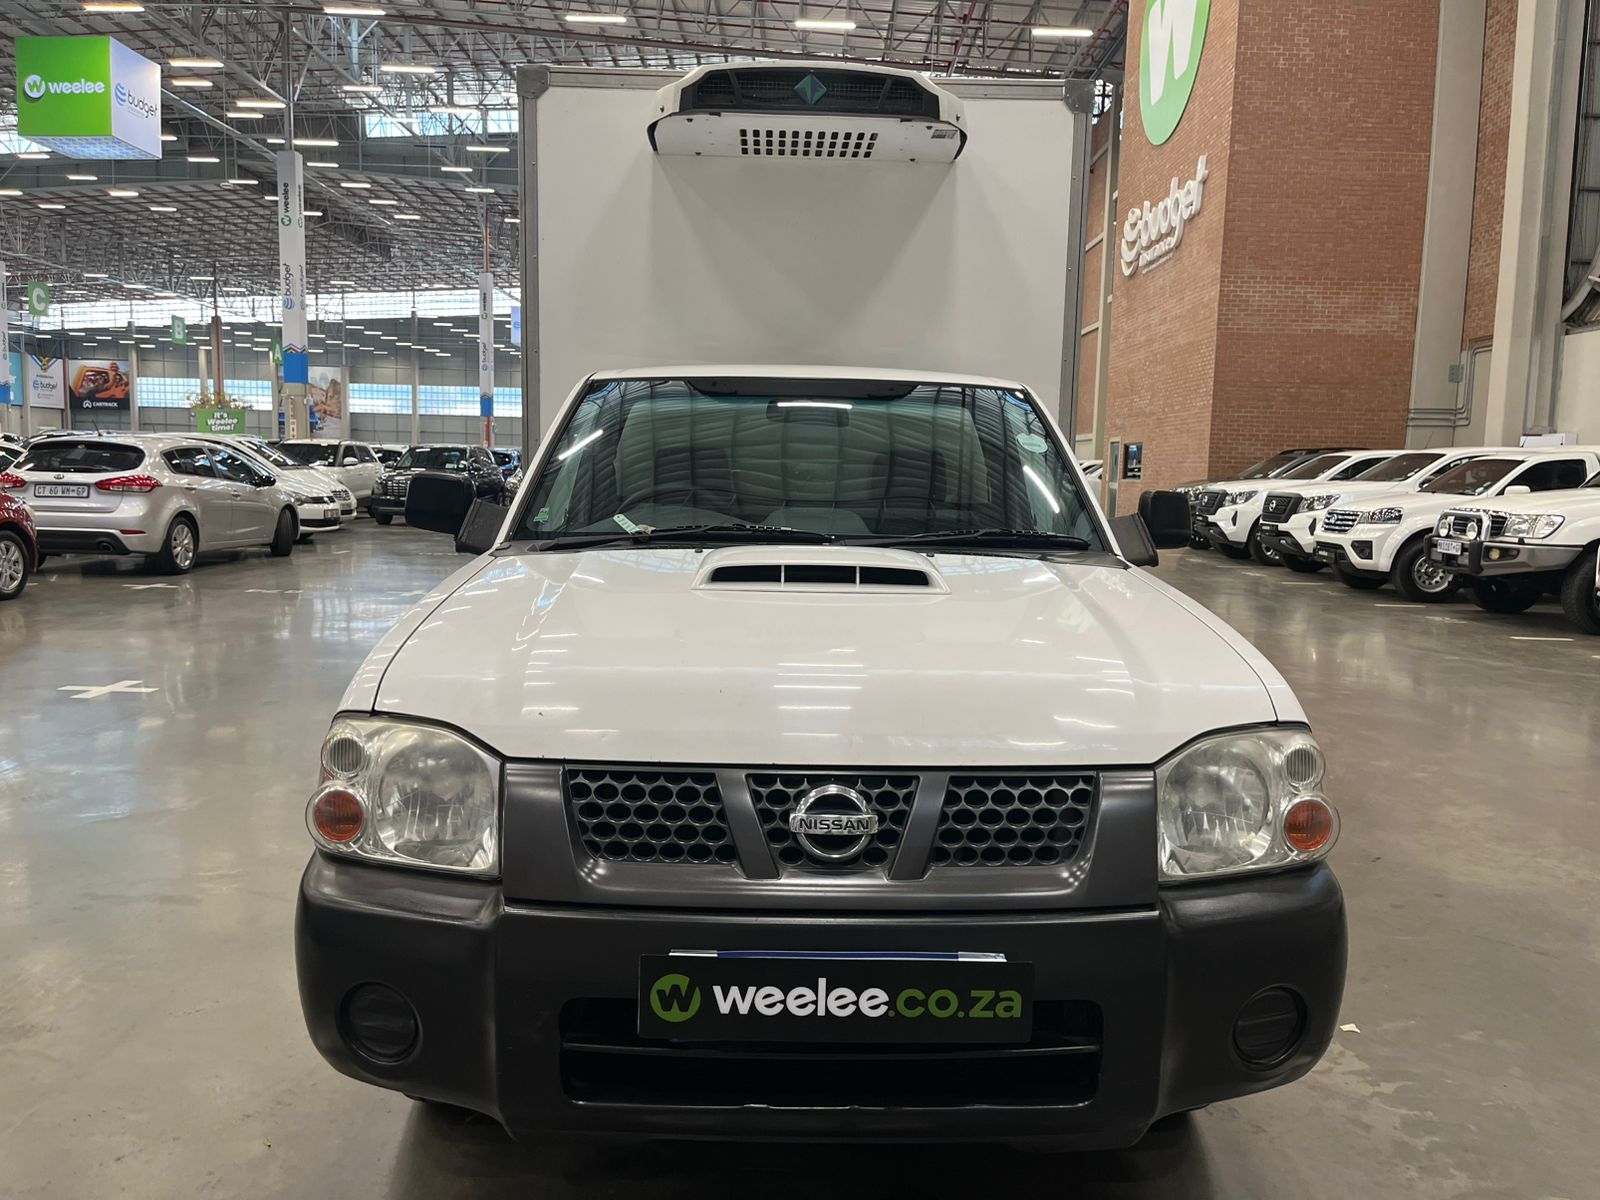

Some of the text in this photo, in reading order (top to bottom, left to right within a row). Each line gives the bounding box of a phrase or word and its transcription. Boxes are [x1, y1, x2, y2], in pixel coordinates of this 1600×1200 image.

[48, 79, 105, 94] weelee
[127, 89, 158, 118] budget
[282, 182, 290, 213] weelee
[1140, 154, 1208, 249] budget
[283, 263, 294, 297] budget
[32, 287, 46, 311] C
[174, 319, 184, 339] B
[274, 343, 282, 361] A
[40, 380, 58, 392] budget
[37, 486, 46, 495] CT
[799, 818, 869, 830] NISSAN
[712, 976, 1023, 1019] weelee.co.za
